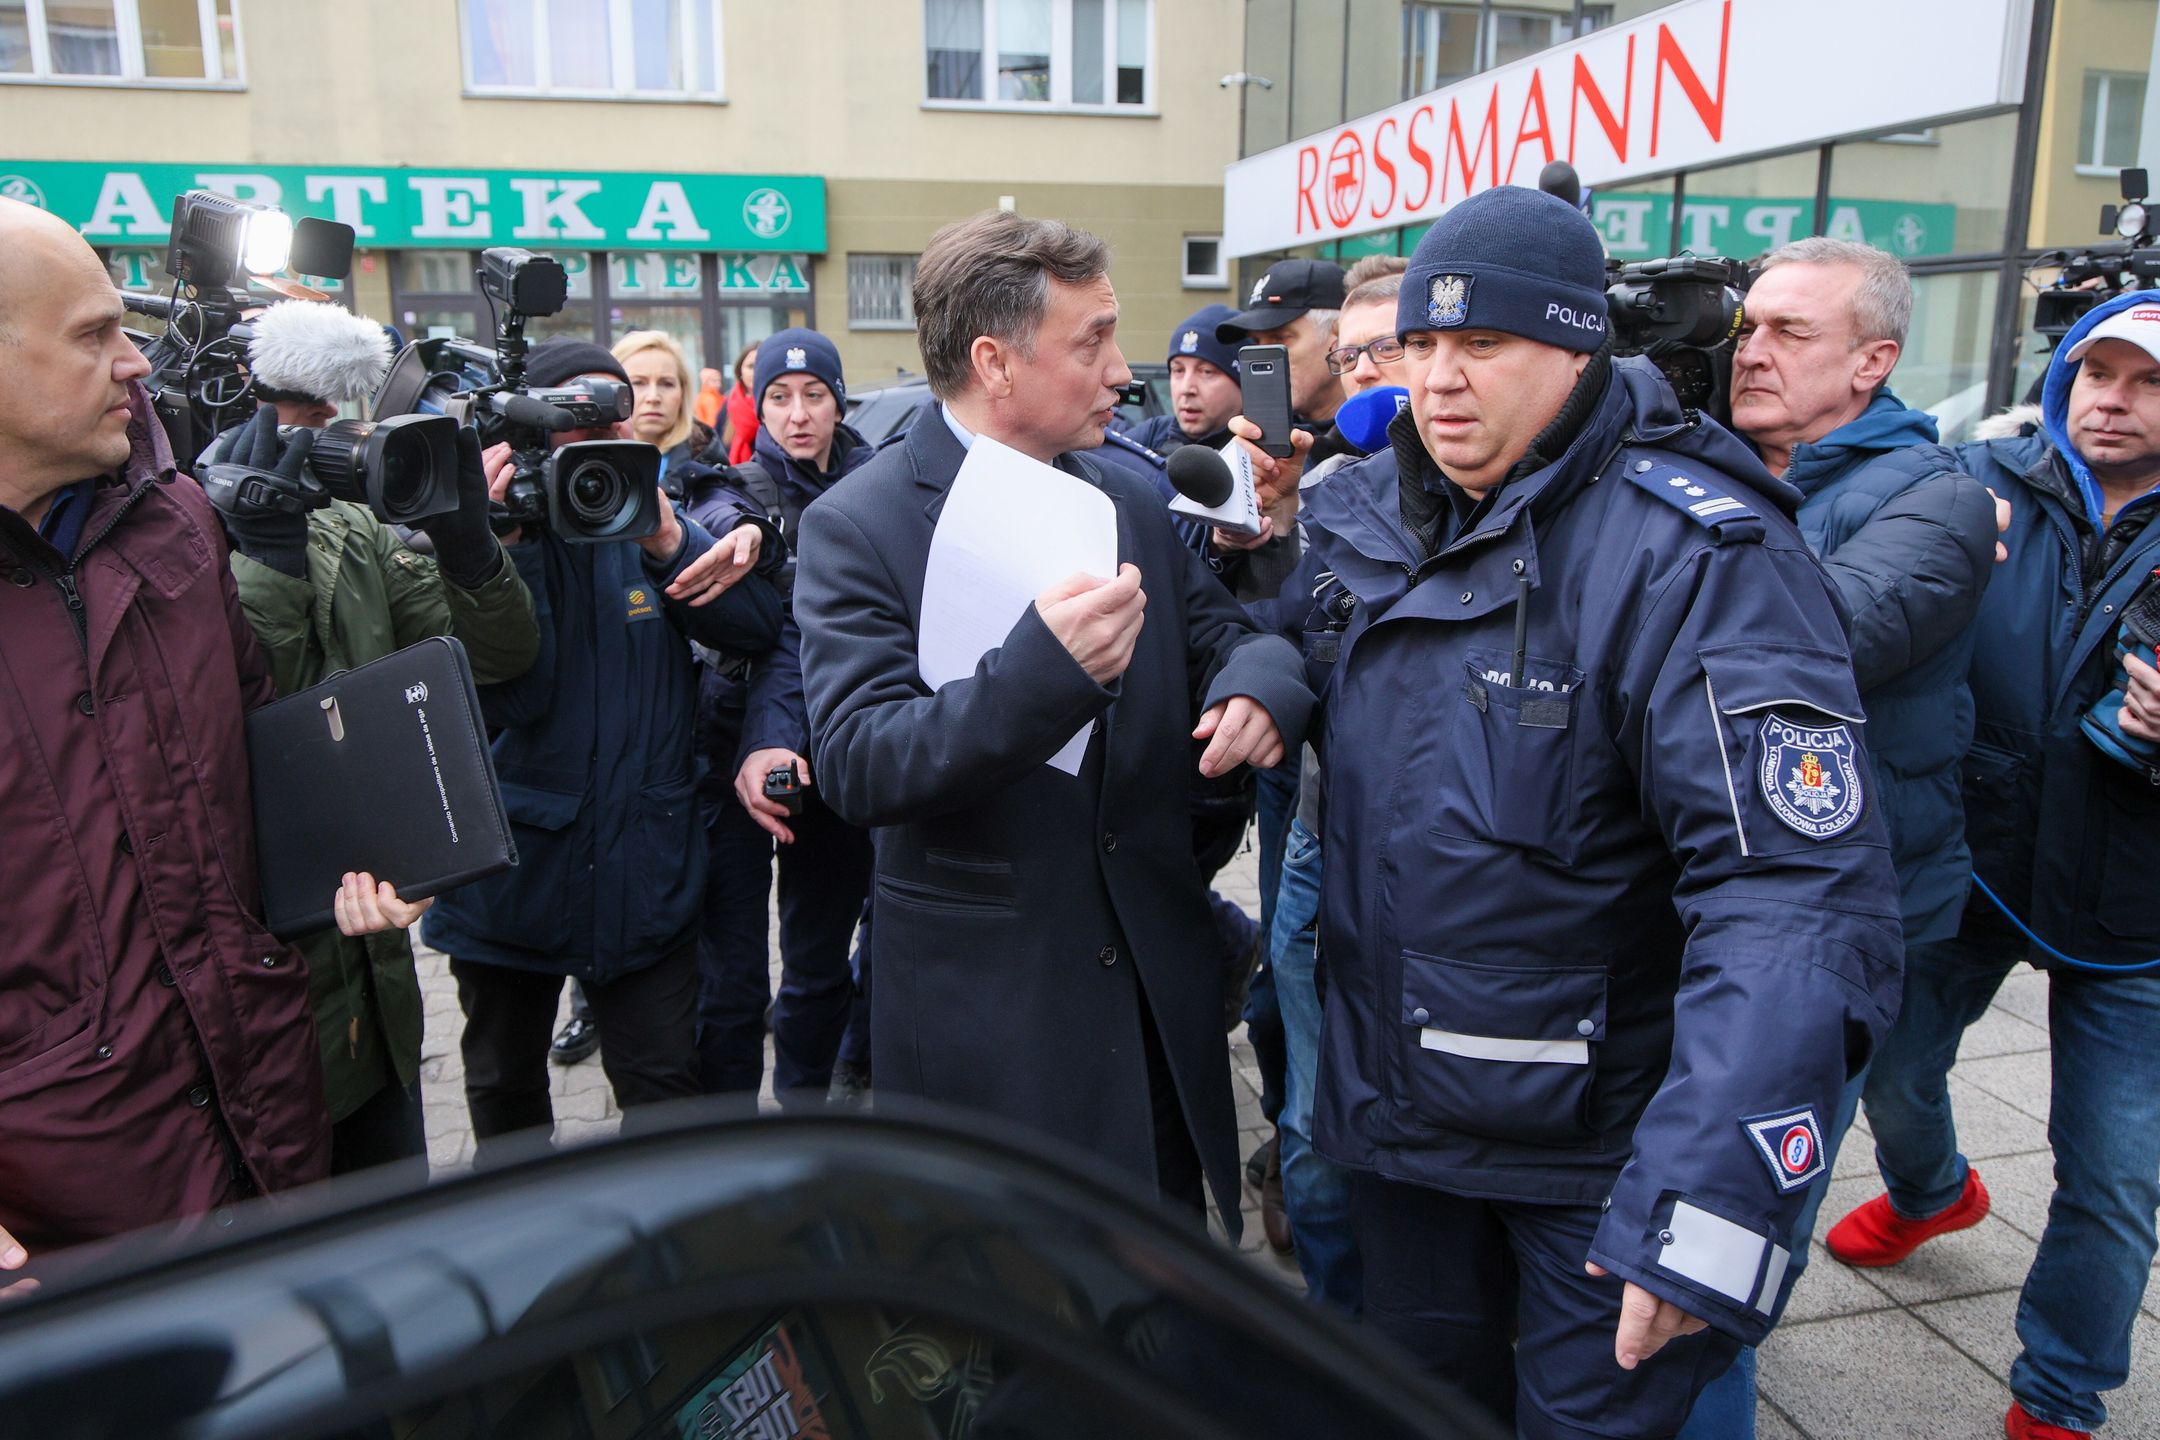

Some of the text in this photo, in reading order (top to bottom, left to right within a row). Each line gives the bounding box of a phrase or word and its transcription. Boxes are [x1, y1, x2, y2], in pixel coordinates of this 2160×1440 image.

[1296, 0, 1732, 234] ROSSMANN
[1545, 302, 1606, 333] POLICJ
[208, 474, 234, 488] Canon
[1768, 721, 1846, 747] POLICJA
[417, 708, 459, 843] Comando Metropolitano de Lisboa da PSP
[1764, 745, 1777, 795] KOMENDA
[1842, 761, 1861, 814] WARSZAWA
[1769, 793, 1818, 833] REJONOWA
[1818, 811, 1851, 833] POLICJI
